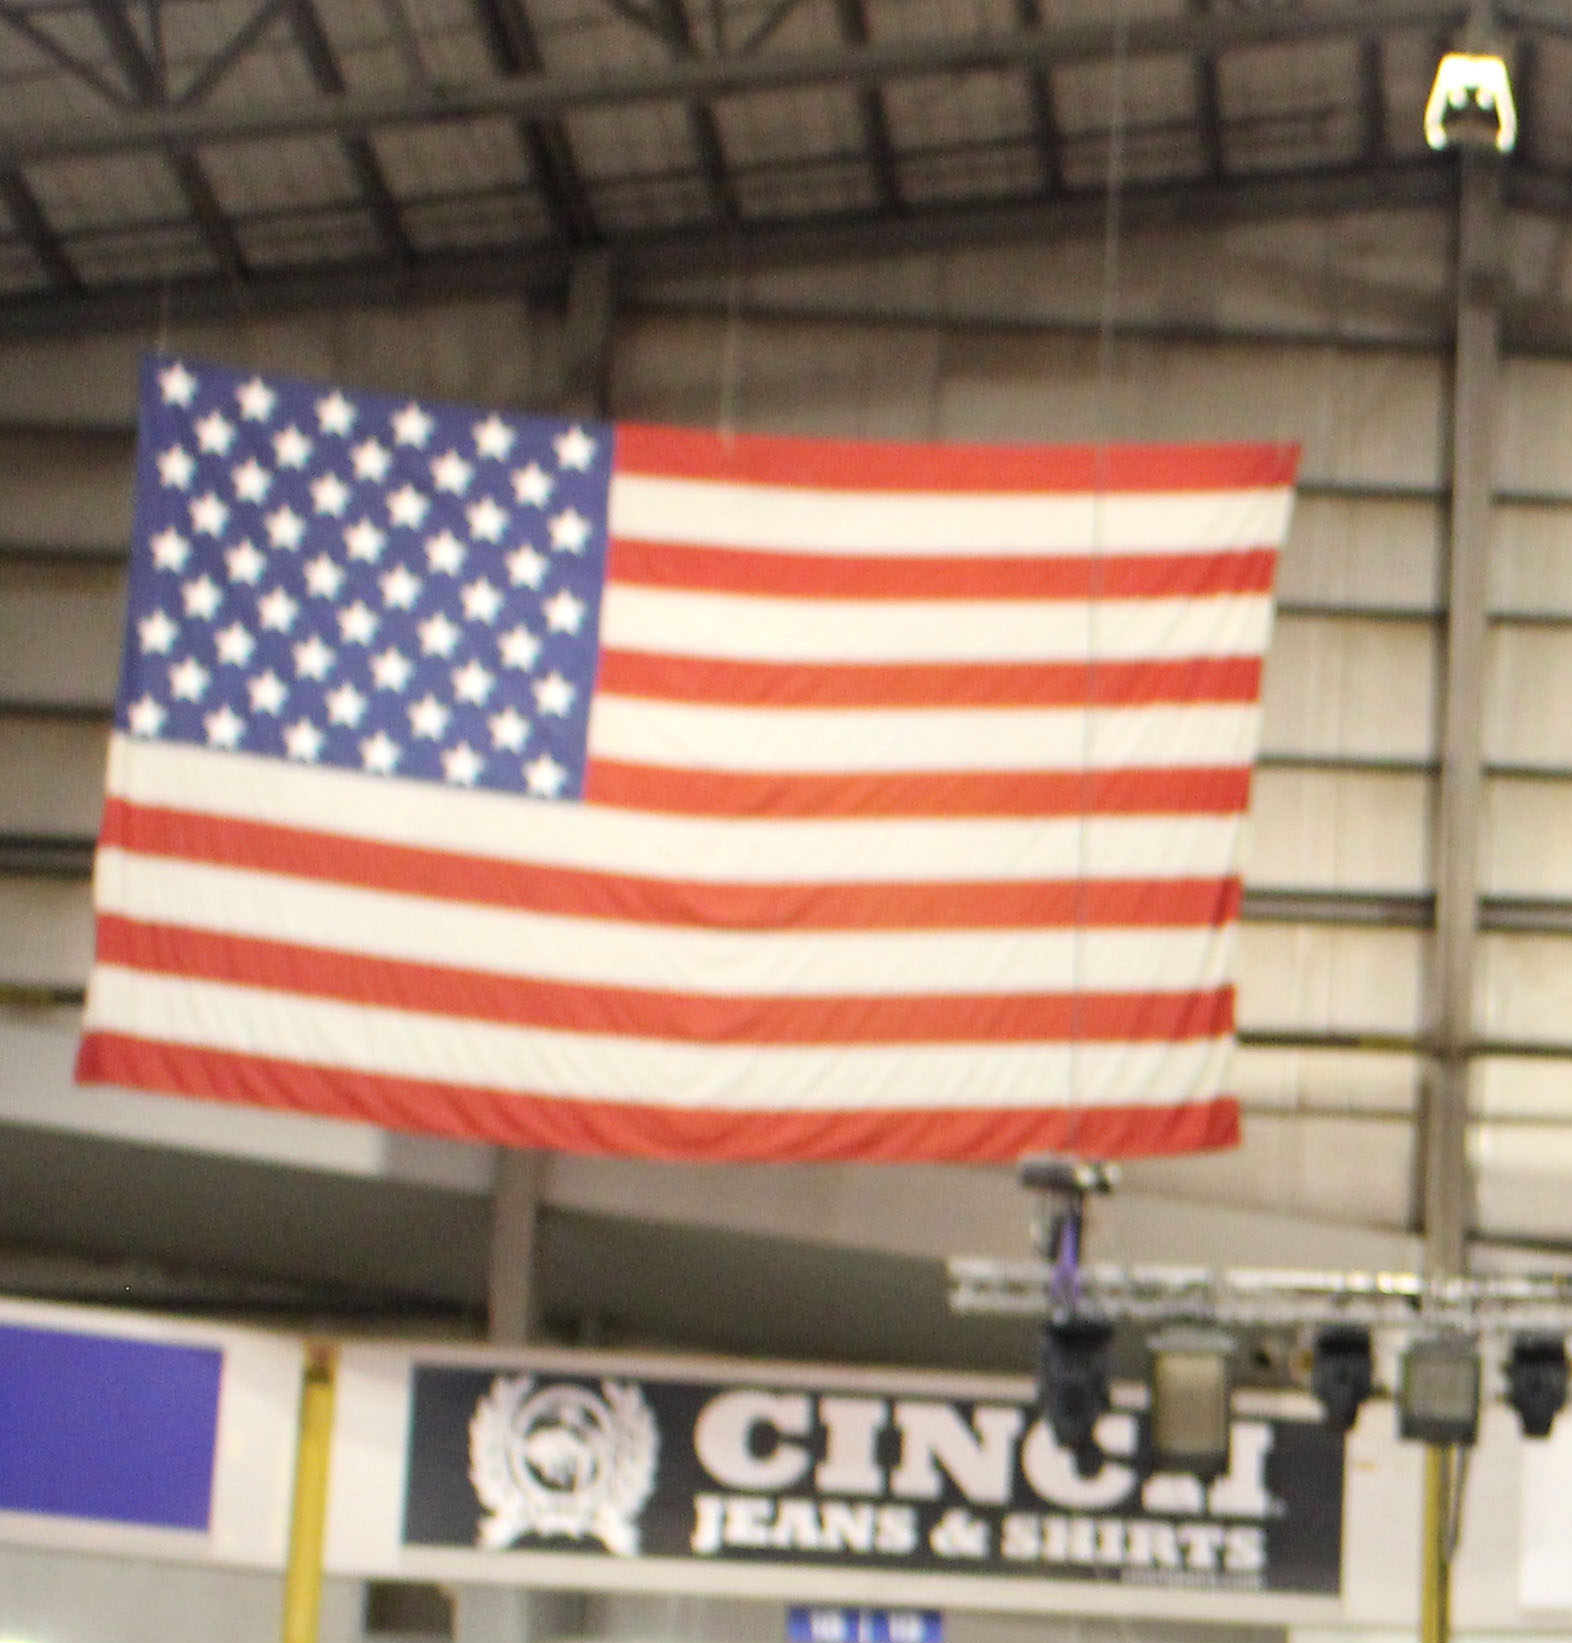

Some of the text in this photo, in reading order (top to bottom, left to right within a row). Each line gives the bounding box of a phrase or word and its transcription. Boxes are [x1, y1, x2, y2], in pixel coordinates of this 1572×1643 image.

[691, 1495, 1265, 1571] JEANS & SHIRTS
